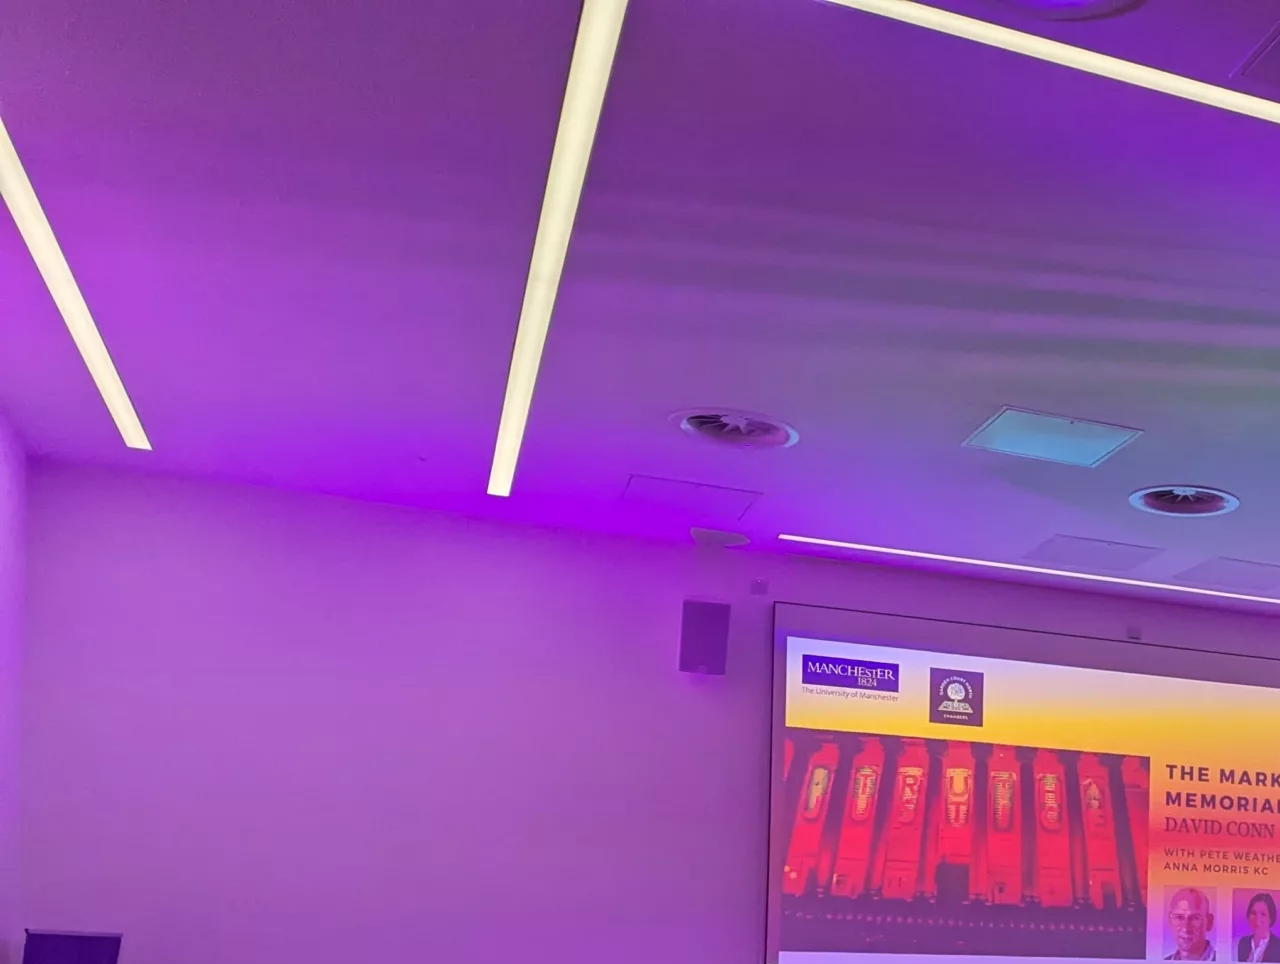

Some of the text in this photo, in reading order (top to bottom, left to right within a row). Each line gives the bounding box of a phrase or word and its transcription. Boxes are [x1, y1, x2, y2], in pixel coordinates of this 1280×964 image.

[807, 662, 896, 681] MANCHESTER
[857, 677, 877, 688] 1824
[802, 686, 899, 702] The University of Manchester
[943, 713, 968, 721] CHAMBERS
[1165, 764, 1210, 783] THE
[1163, 816, 1276, 839] DAVID CONN
[1164, 848, 1196, 859] WITH
[1200, 849, 1229, 860] PETE
[1163, 862, 1270, 877] ANNA MORRIS KC
